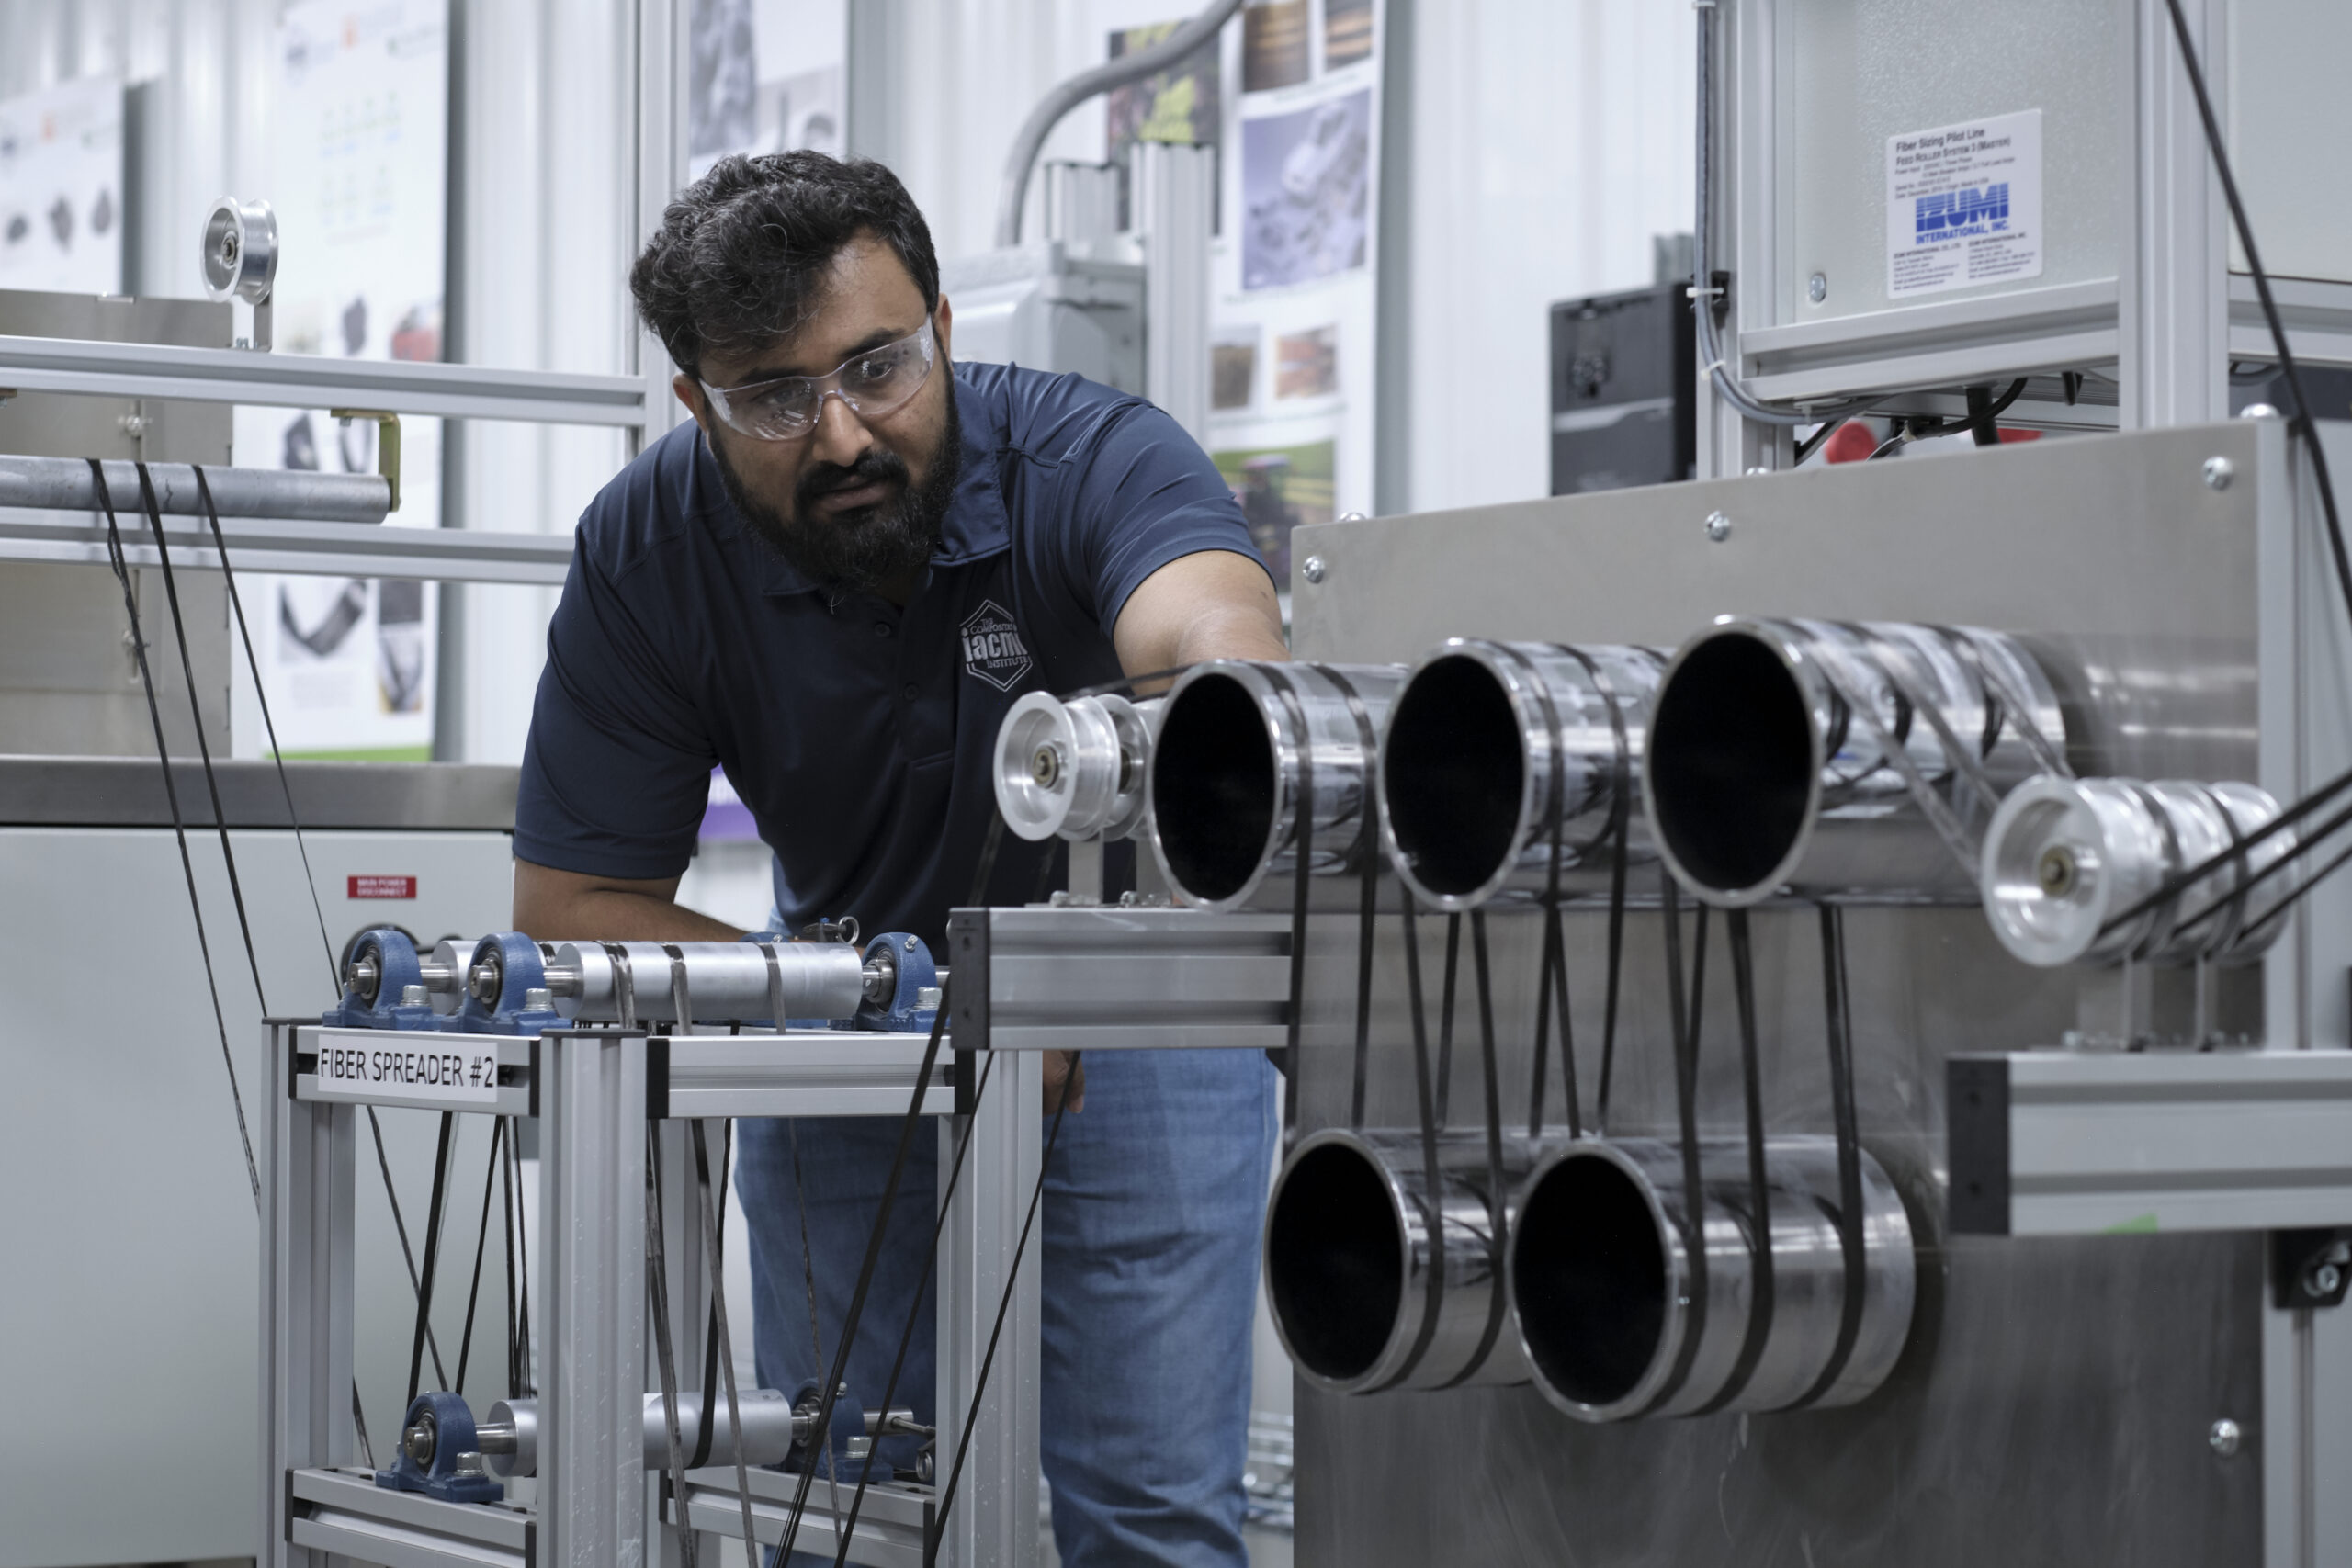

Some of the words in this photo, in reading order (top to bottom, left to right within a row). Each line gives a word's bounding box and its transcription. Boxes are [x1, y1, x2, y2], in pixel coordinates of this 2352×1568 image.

[1896, 141, 1917, 152] Fiber
[1918, 136, 1944, 148] Sizing
[1946, 132, 1965, 143] Pilot
[1967, 129, 1985, 139] Line
[1916, 182, 2009, 232] IZUMI
[1916, 224, 1989, 244] INTERNATIONAL,
[1991, 220, 2010, 232] INC.
[986, 656, 1029, 669] INSTITUTE
[321, 1048, 368, 1080] FIBER
[372, 1051, 464, 1087] SPREADER
[469, 1056, 494, 1088] #2
